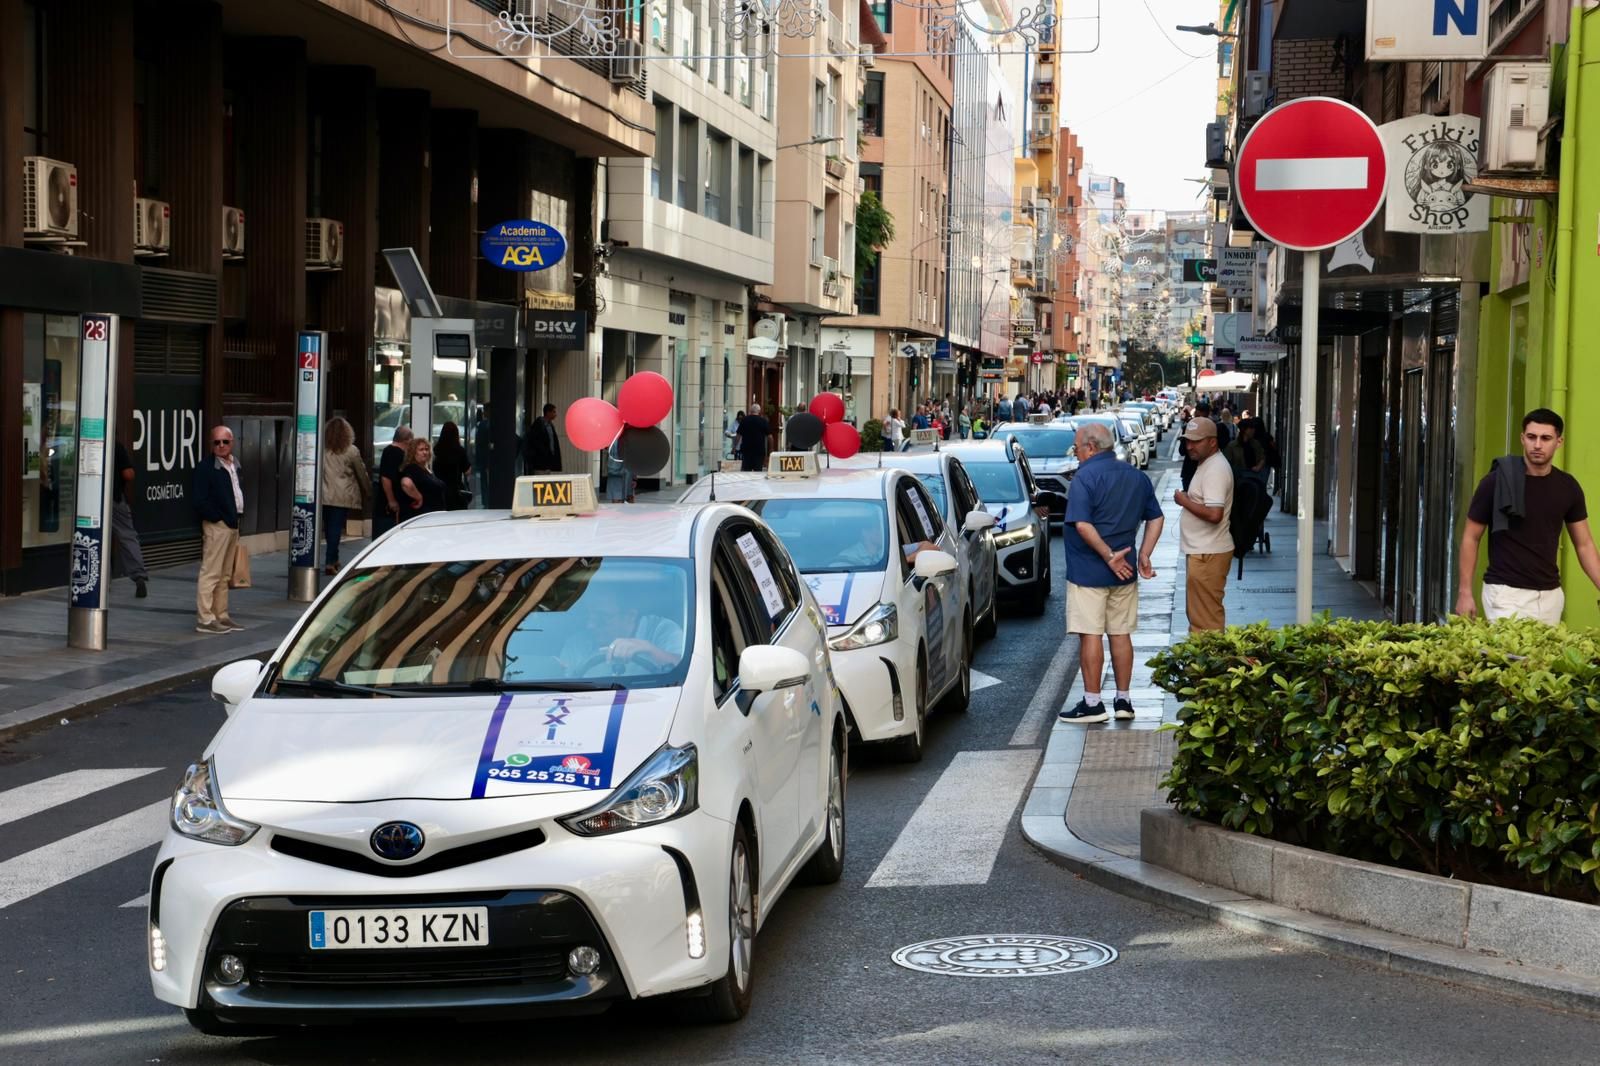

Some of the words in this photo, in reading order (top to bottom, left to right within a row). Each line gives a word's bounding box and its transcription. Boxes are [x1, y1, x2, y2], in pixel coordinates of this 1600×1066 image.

[1432, 0, 1478, 36] N
[1401, 121, 1480, 153] Friki's
[1408, 203, 1469, 229] Shop
[500, 225, 546, 236] Academia
[1427, 223, 1452, 231] Alicante
[501, 245, 544, 266] AGA
[85, 320, 106, 341] 23
[534, 320, 577, 333] DKV
[305, 336, 312, 352] 1
[304, 352, 313, 369] 2
[132, 408, 203, 472] PLURI
[780, 457, 804, 471] TAXI
[146, 481, 184, 501] COSMÉTICA
[533, 483, 571, 505] TAXI
[488, 768, 522, 779] 965
[526, 770, 549, 781] 25
[553, 772, 576, 783] 25
[582, 774, 601, 787] 11
[333, 915, 410, 945] 0133
[421, 912, 480, 943] KZN
